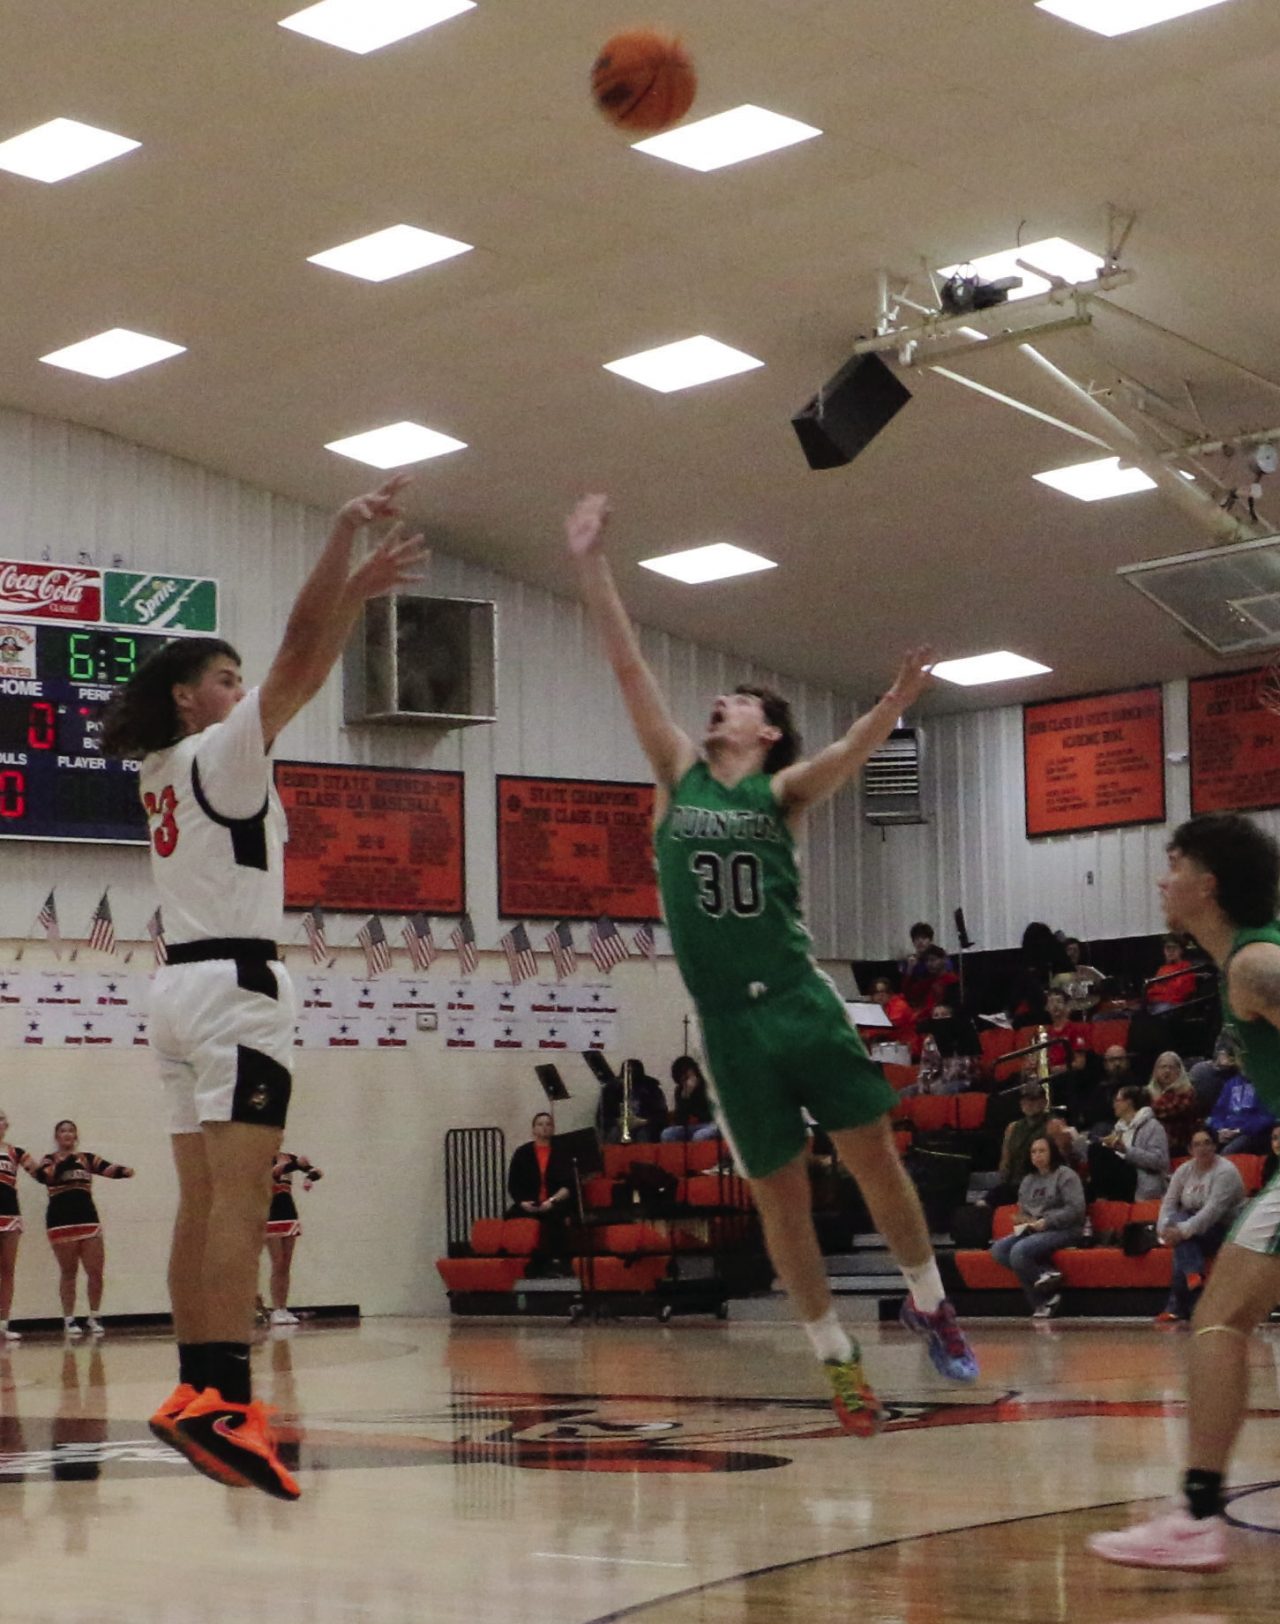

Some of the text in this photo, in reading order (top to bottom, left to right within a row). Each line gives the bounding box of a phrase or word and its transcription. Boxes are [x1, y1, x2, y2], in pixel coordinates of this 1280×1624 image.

[0, 564, 84, 603] Coca-Cola
[134, 579, 177, 623] Sprite
[57, 755, 107, 770] PLAYER
[688, 850, 766, 919] 30
